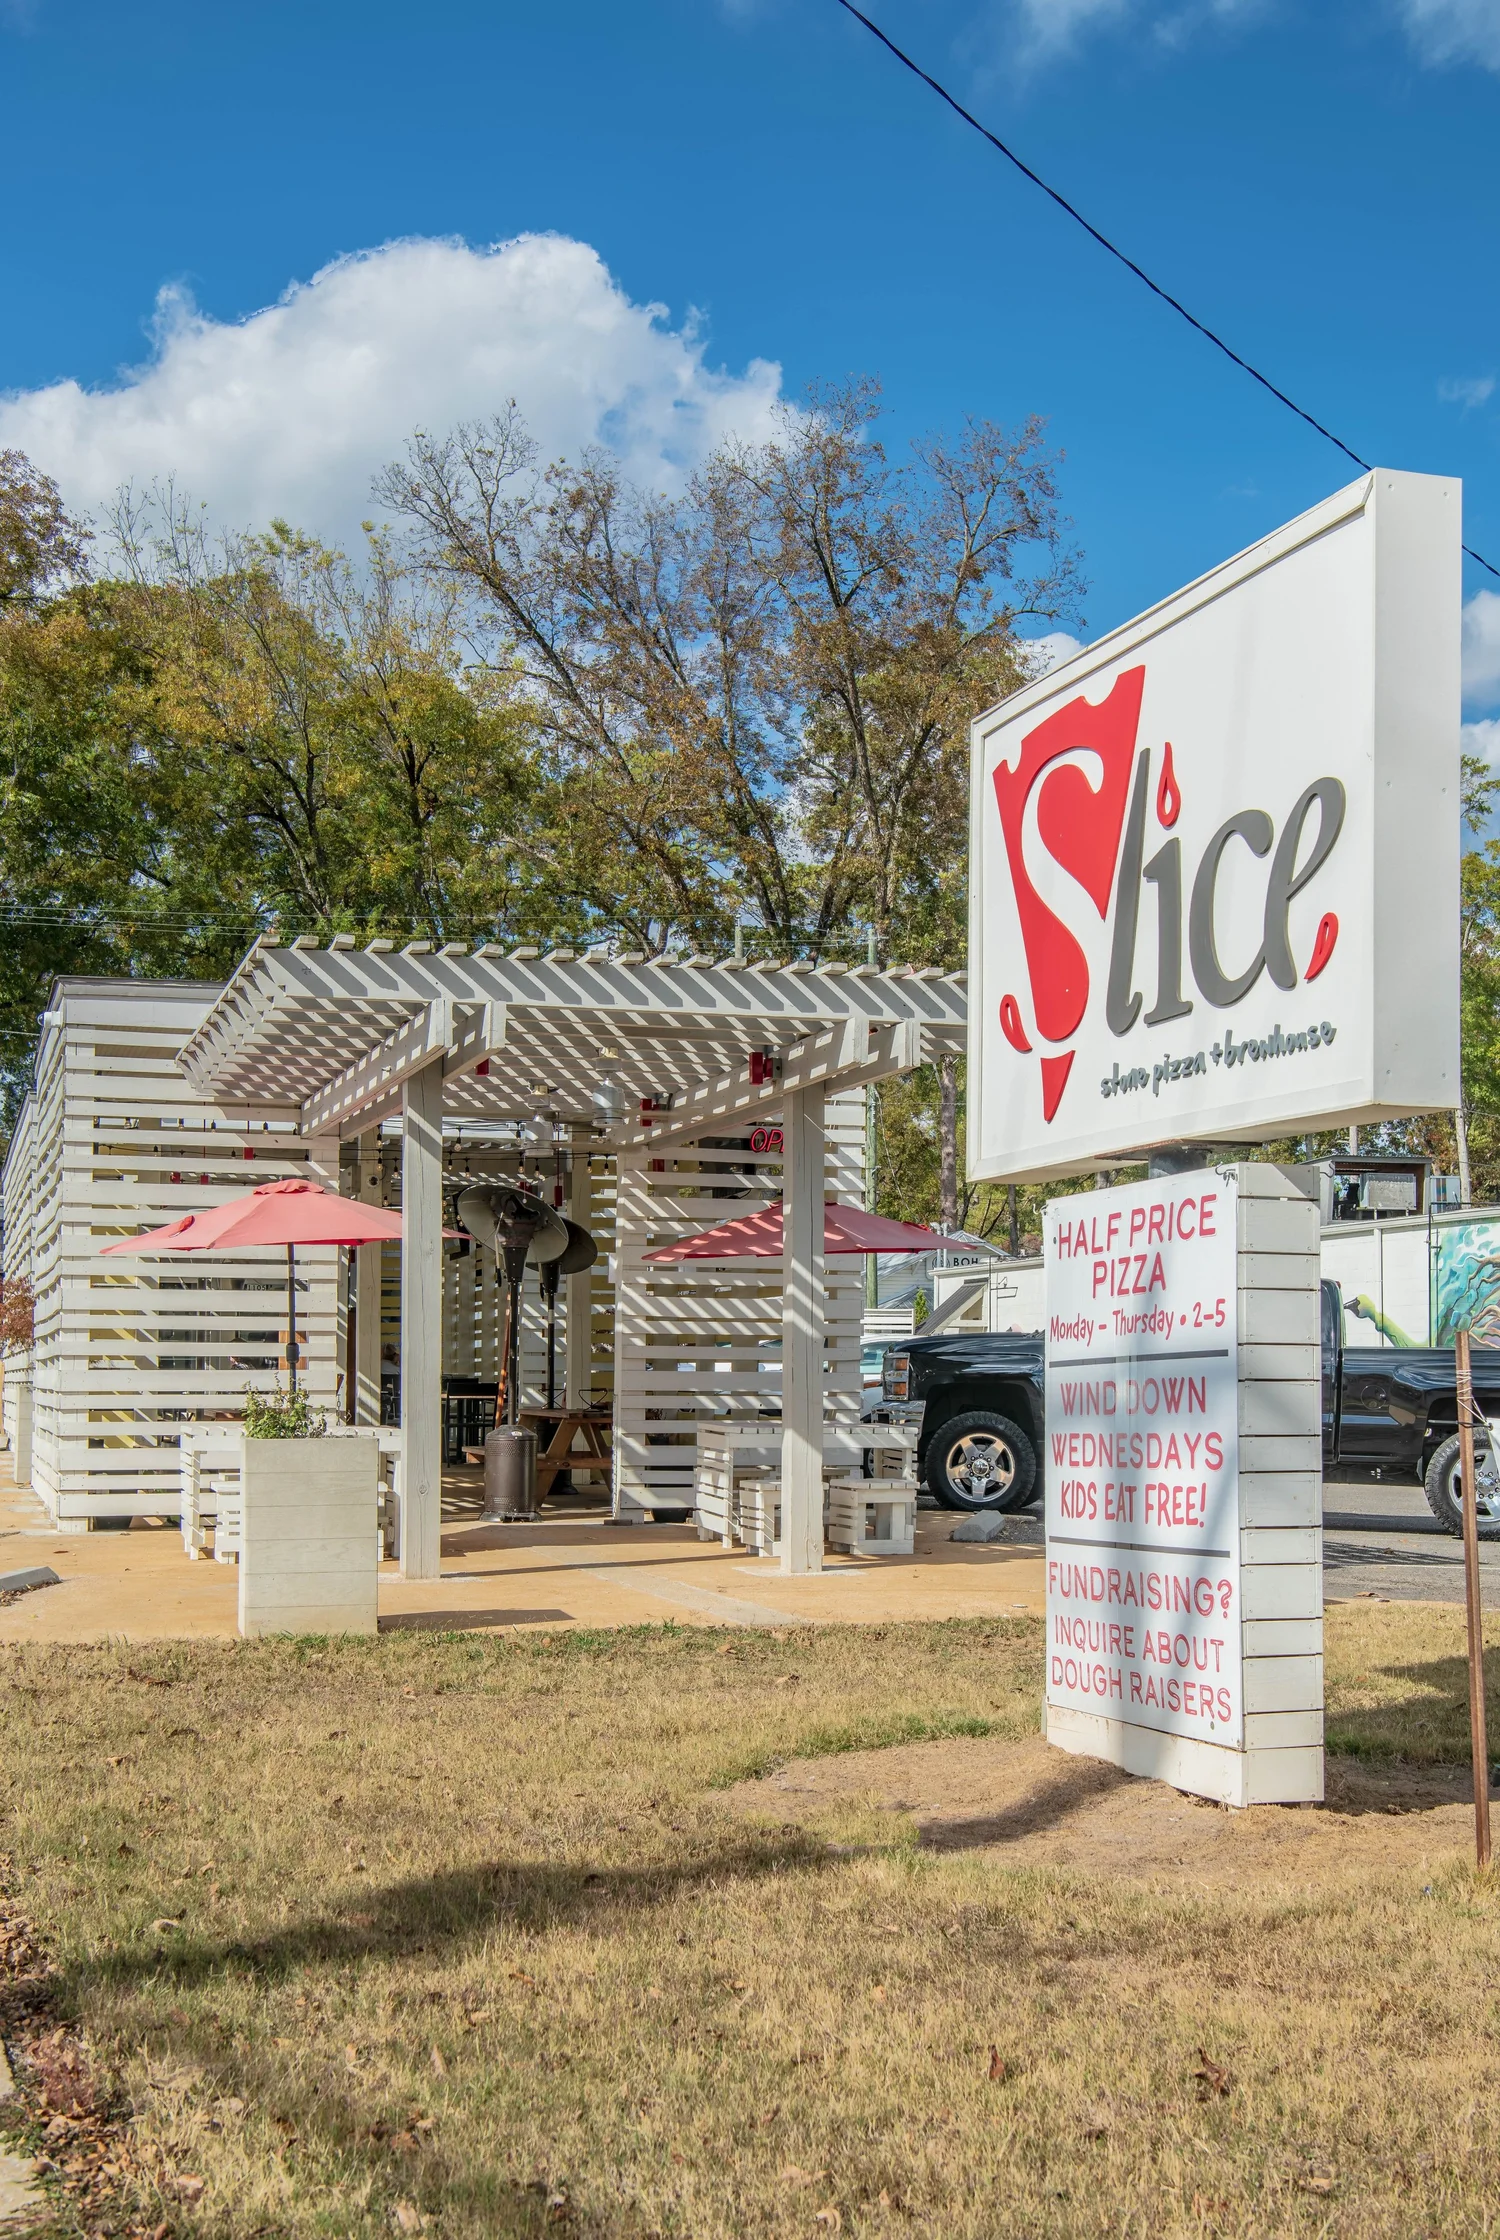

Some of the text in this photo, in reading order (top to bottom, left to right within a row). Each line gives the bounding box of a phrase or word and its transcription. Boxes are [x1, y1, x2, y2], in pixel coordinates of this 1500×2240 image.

[1000, 742, 1345, 1054] Slice
[1101, 1062, 1150, 1098] stone
[1152, 1053, 1207, 1097] pizza
[750, 1127, 785, 1153] OP
[1057, 1193, 1218, 1260] HALF PRICE
[1091, 1251, 1167, 1299] PIZZA
[1050, 1313, 1095, 1347] Monday
[1111, 1304, 1175, 1341] Thursday
[1192, 1298, 1227, 1329] 2-5
[1060, 1376, 1207, 1416] WIND DOWN
[1051, 1431, 1224, 1471] WEDNESDAYS
[1060, 1480, 1208, 1528] KIDS EAT FREE!
[1048, 1560, 1233, 1619] FUNDRAISING?
[1055, 1615, 1225, 1673] INQUIRE ABOUT
[1051, 1655, 1232, 1723] DOUGH RAISERS
